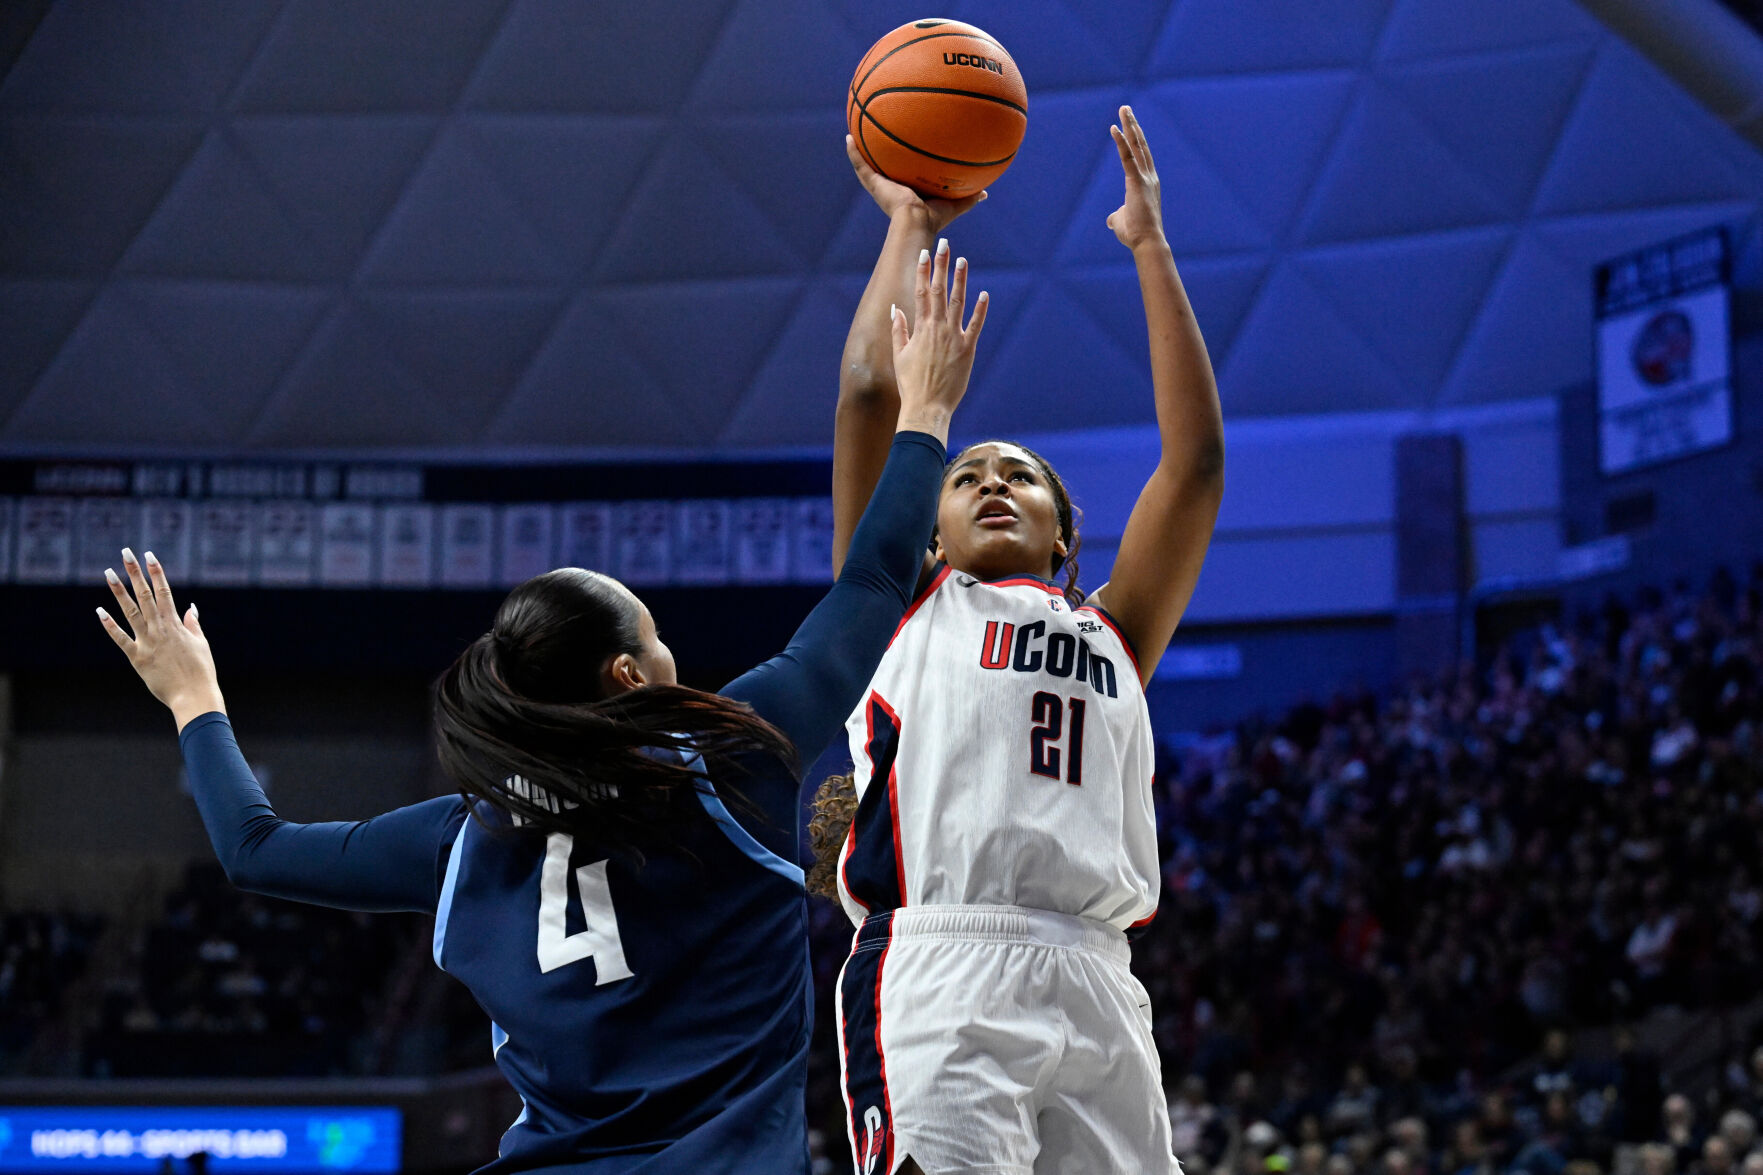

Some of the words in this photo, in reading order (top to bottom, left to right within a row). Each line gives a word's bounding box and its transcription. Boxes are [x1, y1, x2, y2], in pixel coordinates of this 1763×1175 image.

[943, 53, 1003, 75] UCONN
[1030, 690, 1087, 787] 21
[537, 832, 636, 987] 4
